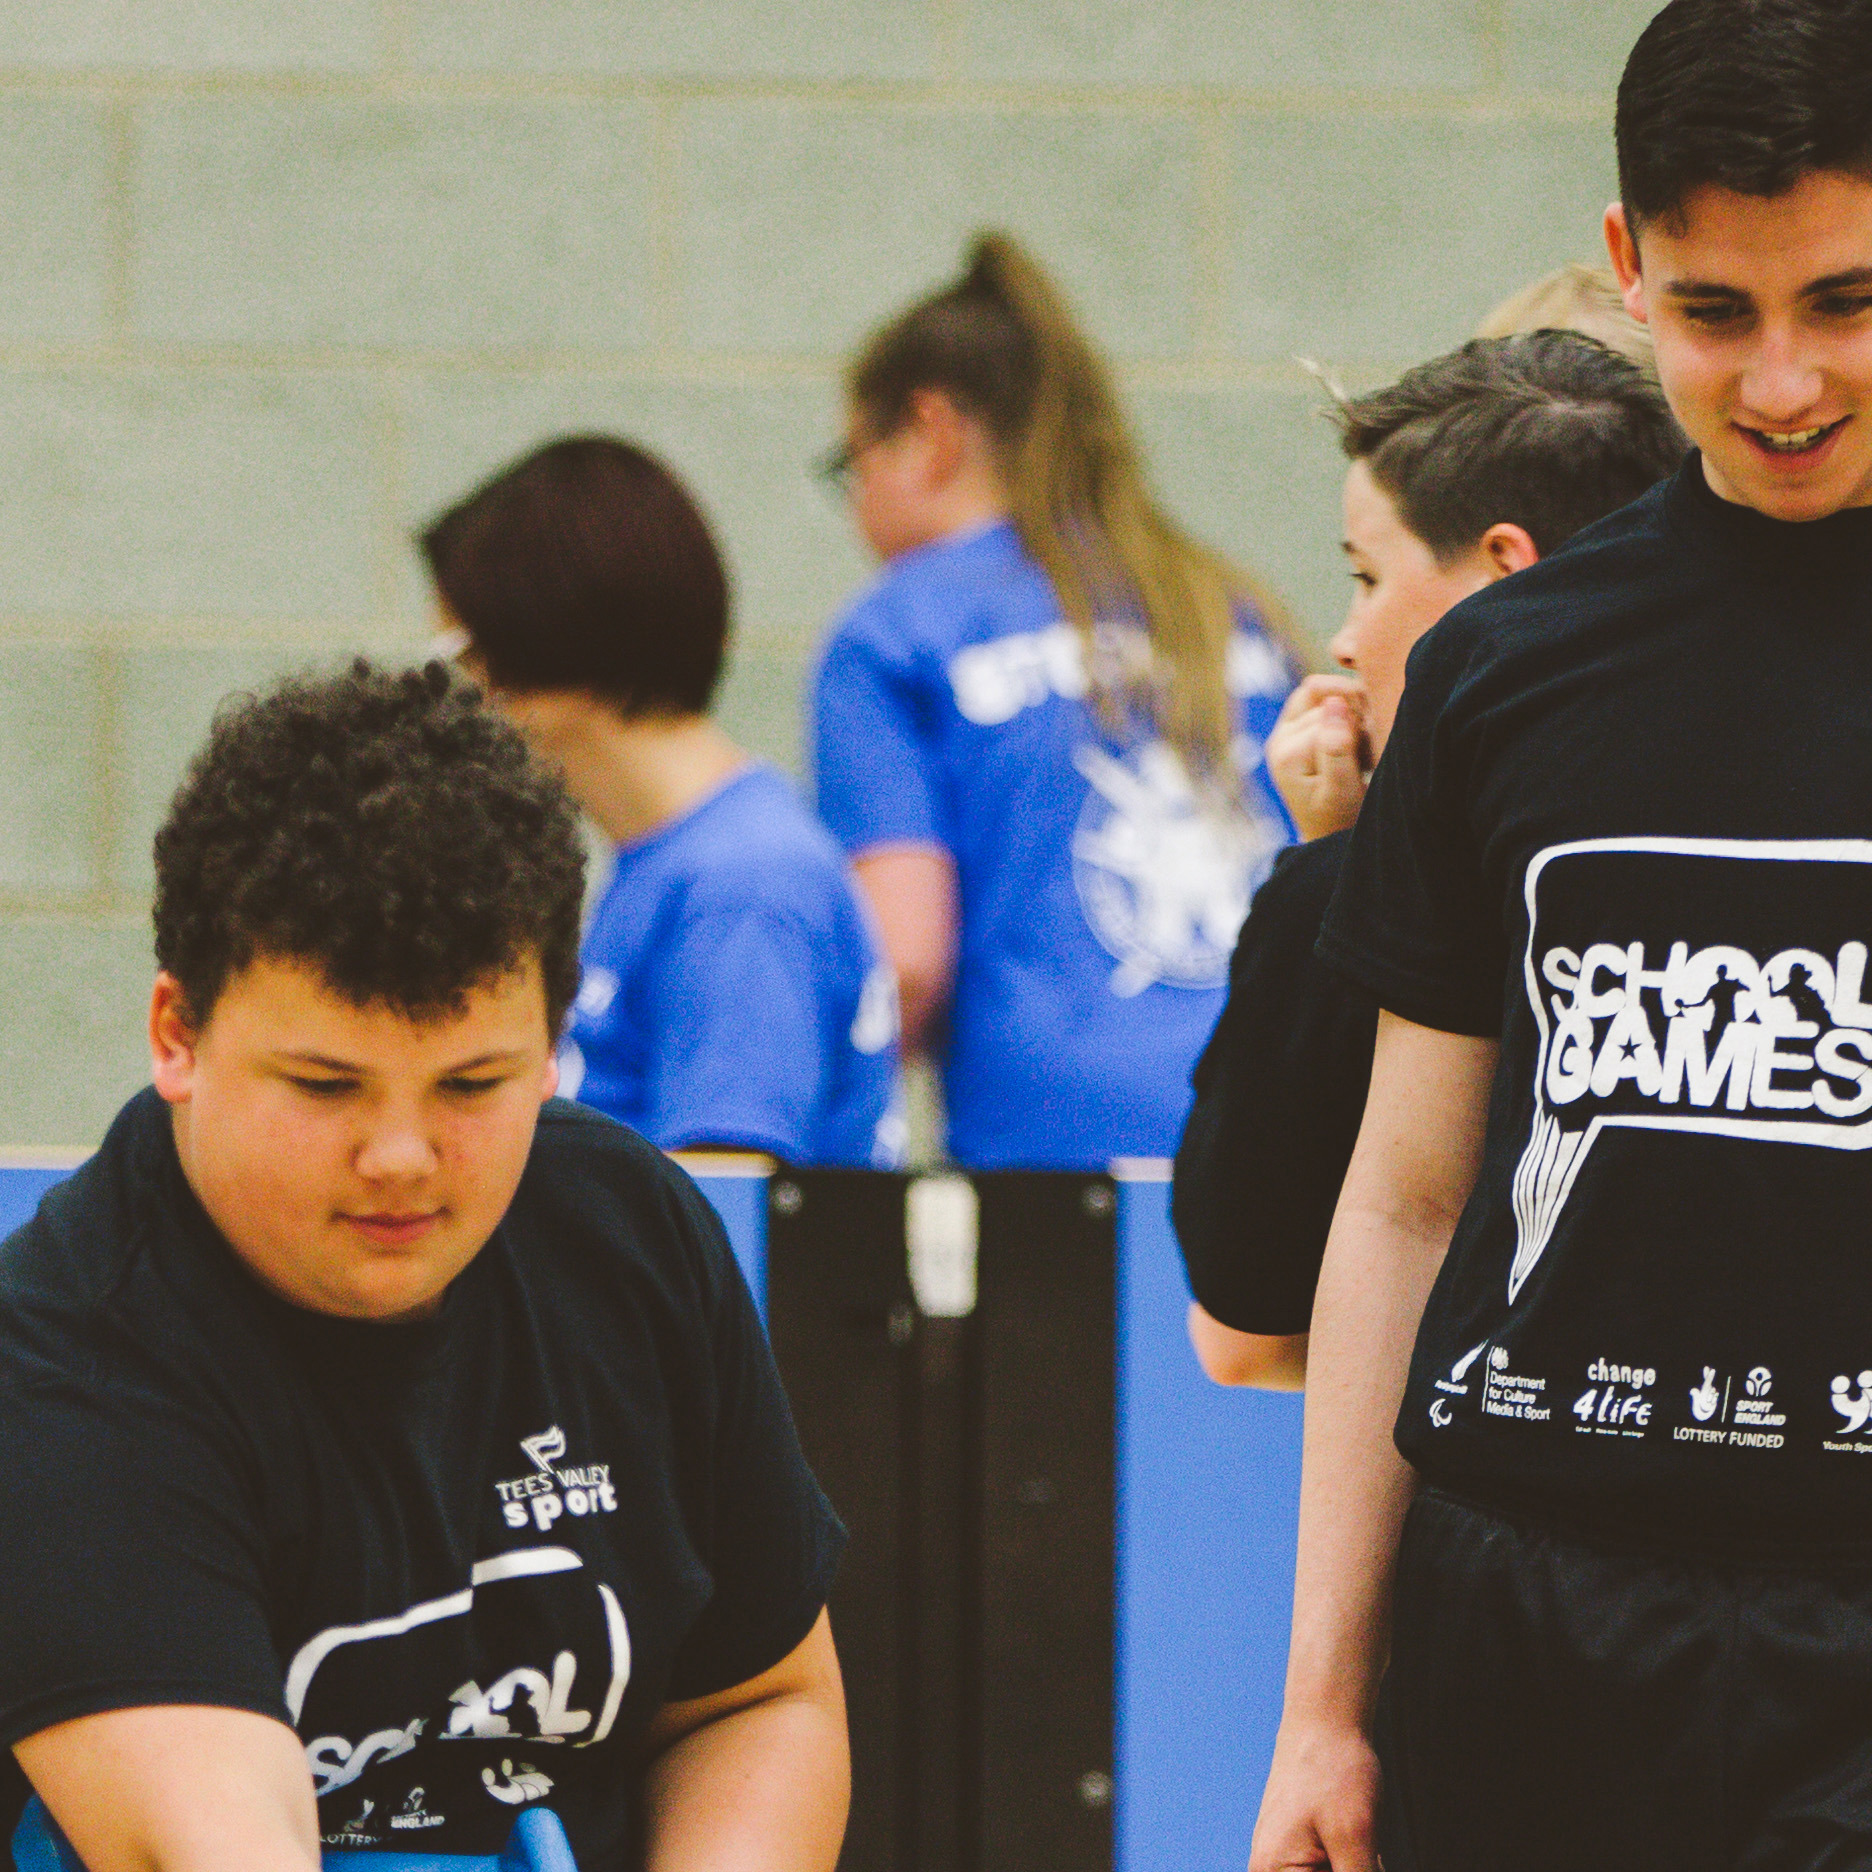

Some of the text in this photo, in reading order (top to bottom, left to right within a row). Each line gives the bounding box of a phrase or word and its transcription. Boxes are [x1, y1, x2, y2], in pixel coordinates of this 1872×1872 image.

[1489, 1371, 1546, 1391] Department
[1587, 1356, 1656, 1390] change
[1488, 1386, 1537, 1405] for Culture
[1486, 1400, 1551, 1421] Media & Sport
[1736, 1399, 1775, 1414] SPORT
[1734, 1412, 1787, 1426] ENGLAND
[1673, 1426, 1785, 1449] LOTTERY FUNDED
[1822, 1440, 1853, 1452] Youth
[494, 1472, 554, 1502] TEES
